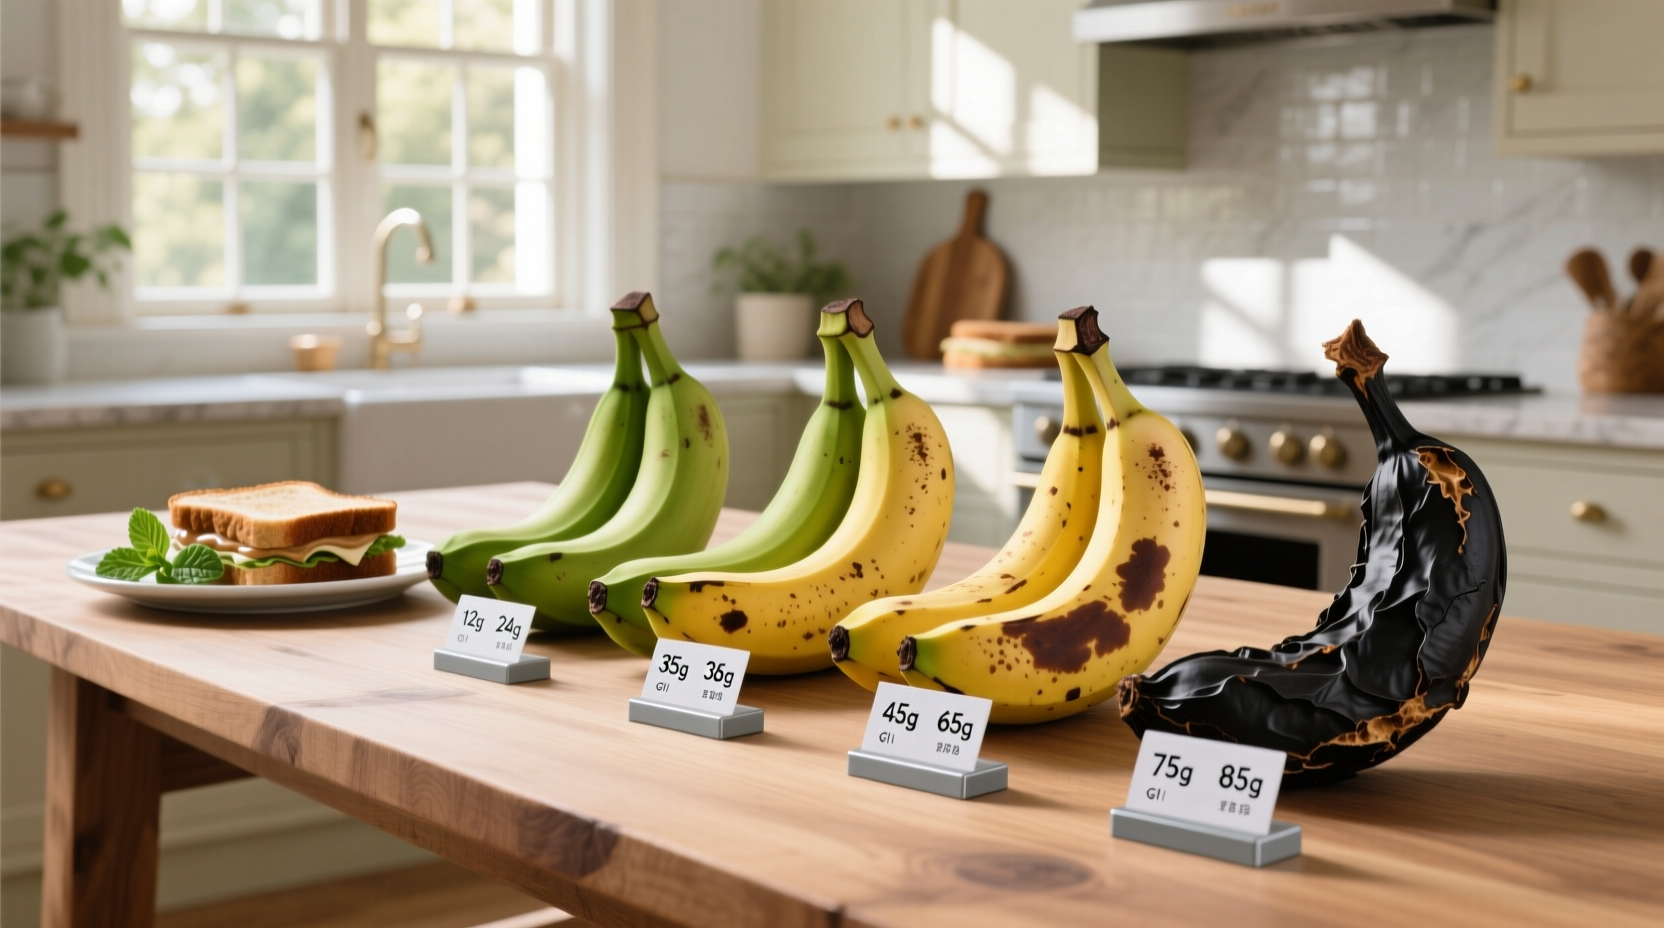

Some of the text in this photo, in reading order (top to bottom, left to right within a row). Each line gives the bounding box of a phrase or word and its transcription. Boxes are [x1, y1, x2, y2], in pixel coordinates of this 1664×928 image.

[463, 610, 521, 640] 12g 24g
[658, 654, 735, 688] 35g 36g
[882, 702, 973, 741] 45g 65g
[1152, 752, 1263, 799] 75g 85g
